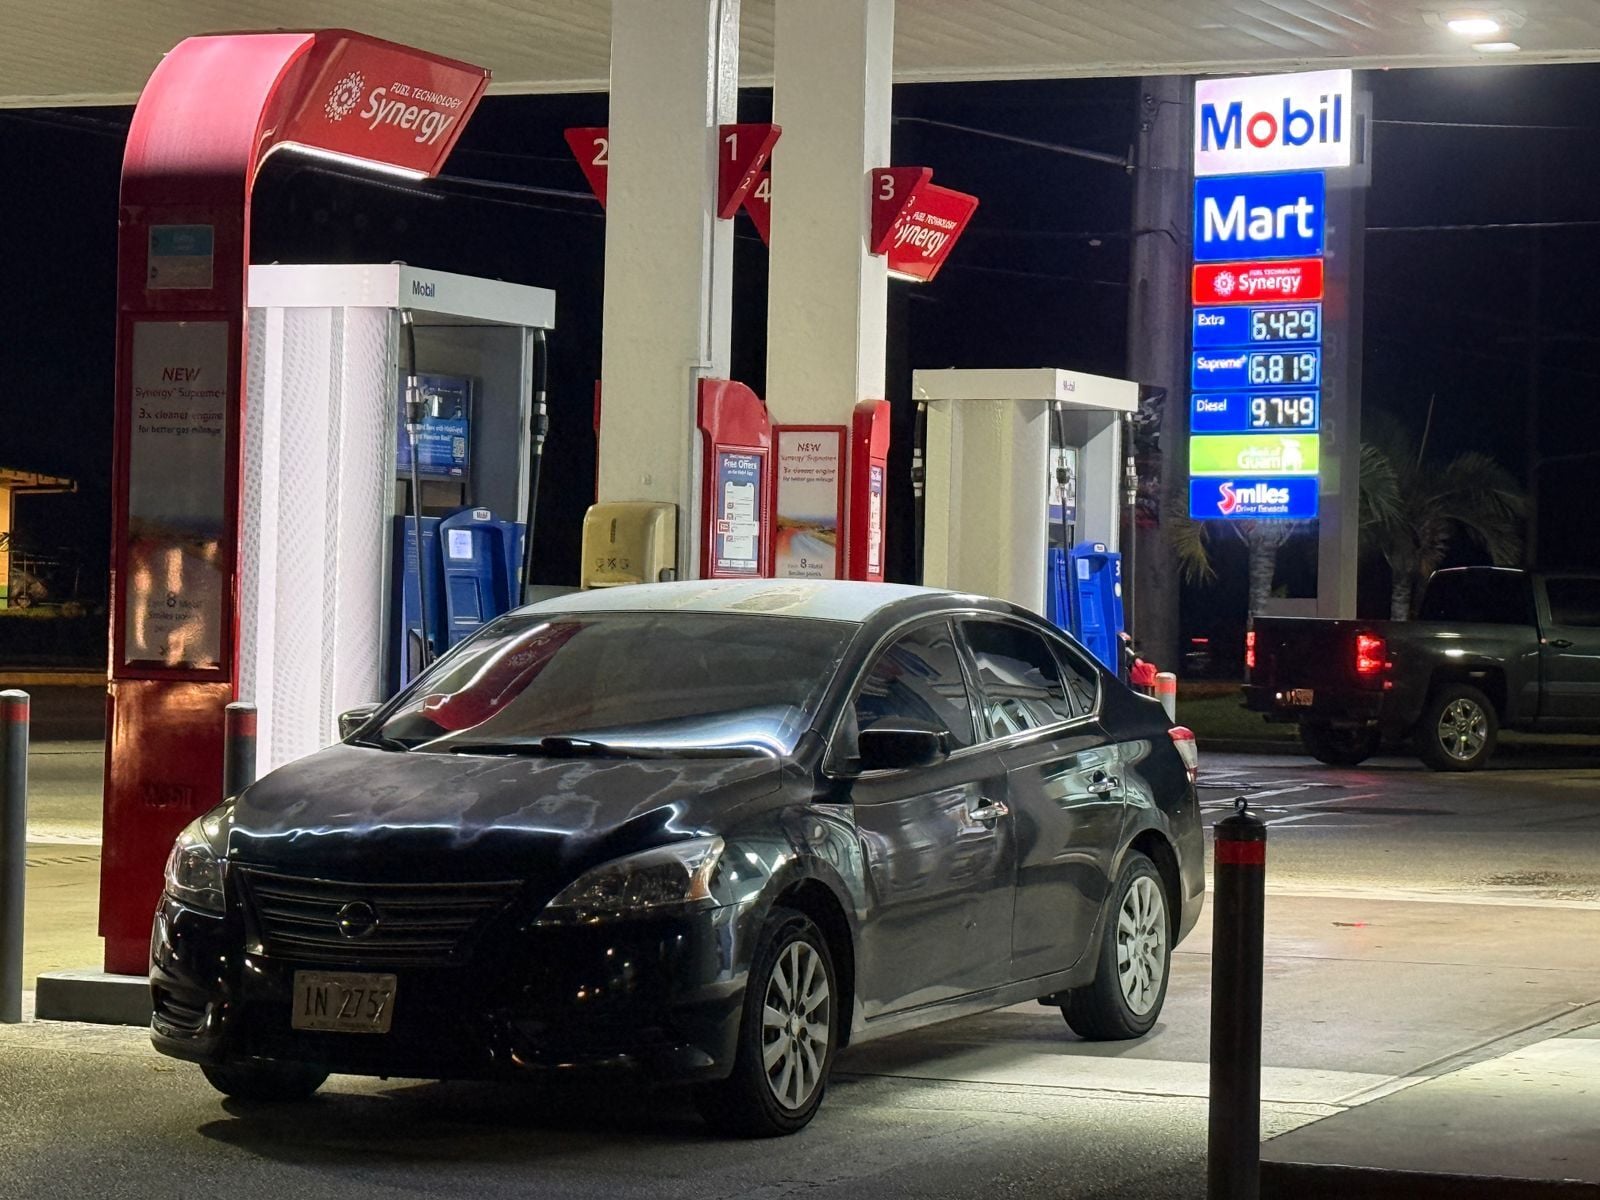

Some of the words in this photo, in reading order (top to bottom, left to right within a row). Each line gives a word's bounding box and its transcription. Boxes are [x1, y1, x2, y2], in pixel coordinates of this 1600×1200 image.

[390, 82, 410, 97] FUEL
[411, 87, 463, 109] TECHNOLOGY
[359, 86, 455, 146] Synergy
[1201, 94, 1341, 151] Mobil
[592, 137, 609, 166] 2
[725, 133, 738, 161] 1
[754, 177, 771, 203] 4
[879, 174, 895, 201] 3
[1204, 196, 1313, 242] Mart
[412, 279, 436, 298] Mobil
[1239, 274, 1301, 294] Synergy
[1198, 314, 1225, 326] Extra
[1253, 311, 1315, 340] 6.429
[161, 367, 201, 382] NEW
[1252, 354, 1314, 383] 6.819
[138, 407, 152, 419] 3x
[154, 410, 189, 420] cleaner
[1196, 398, 1228, 413] Diesel
[1252, 398, 1314, 426] 9.749
[797, 441, 822, 452] NEW
[800, 558, 807, 569] 8
[166, 590, 177, 608] 8
